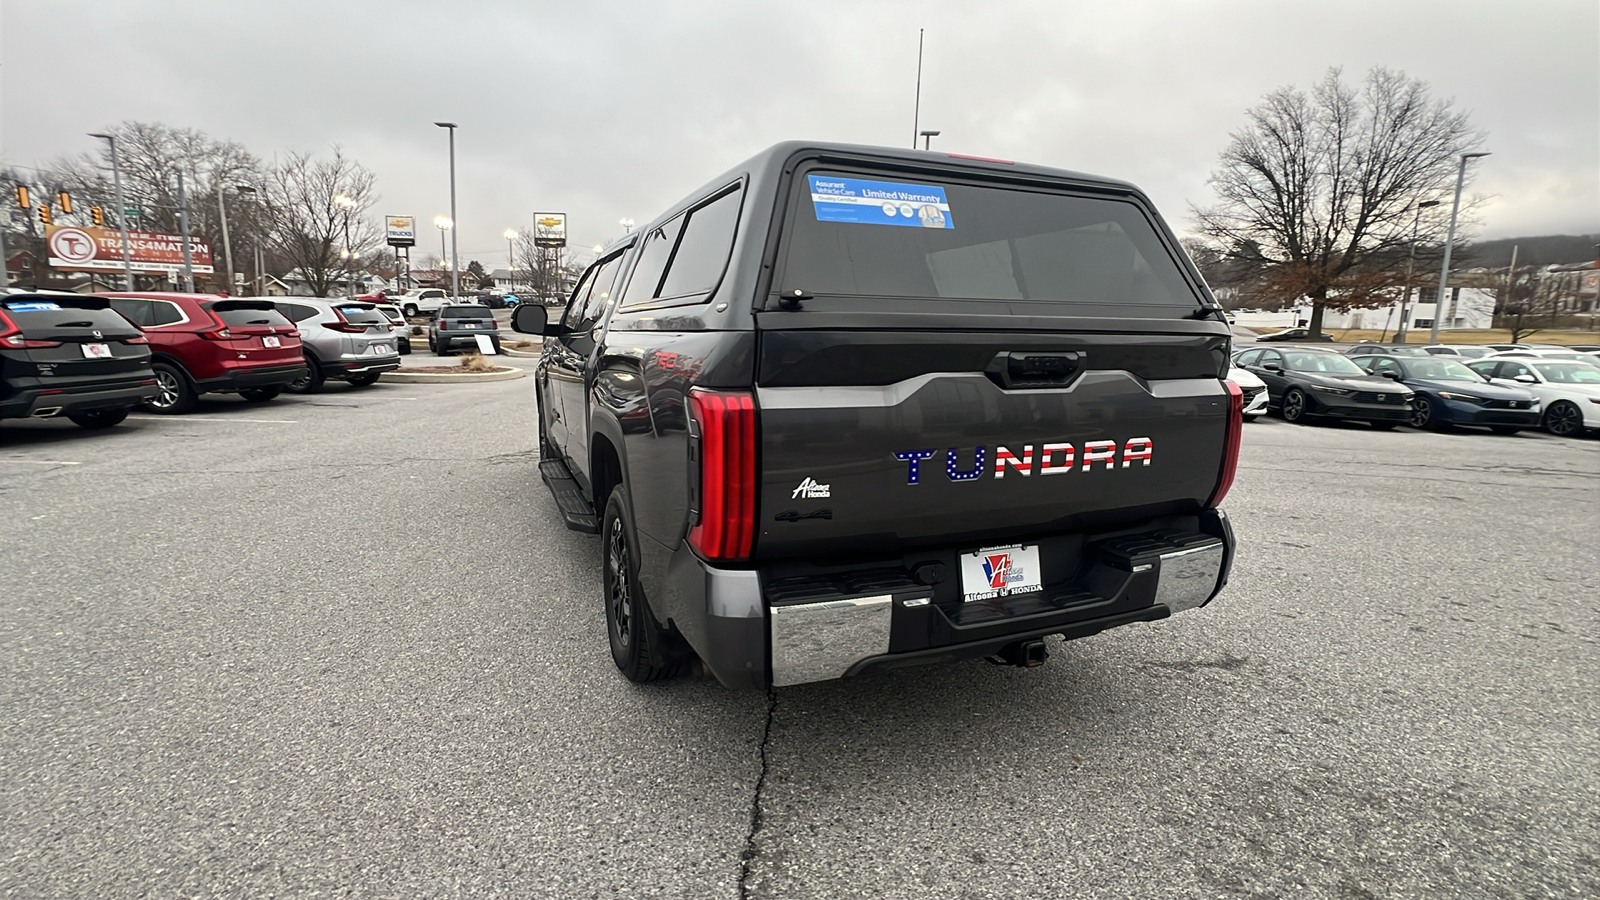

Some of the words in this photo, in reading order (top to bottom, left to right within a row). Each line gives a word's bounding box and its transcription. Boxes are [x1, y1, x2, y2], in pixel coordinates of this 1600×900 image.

[815, 180, 845, 189] Assurant
[816, 187, 840, 195] Vehicle
[841, 188, 855, 197] Care
[861, 189, 898, 200] Limited
[898, 192, 940, 204] Warranty
[98, 238, 208, 254] TRANS4MATON
[654, 351, 679, 371] TRD
[892, 437, 1153, 486] TUNDRA
[807, 490, 831, 498] Honda
[964, 590, 998, 603] Altoona
[1011, 584, 1044, 595] HONDA
